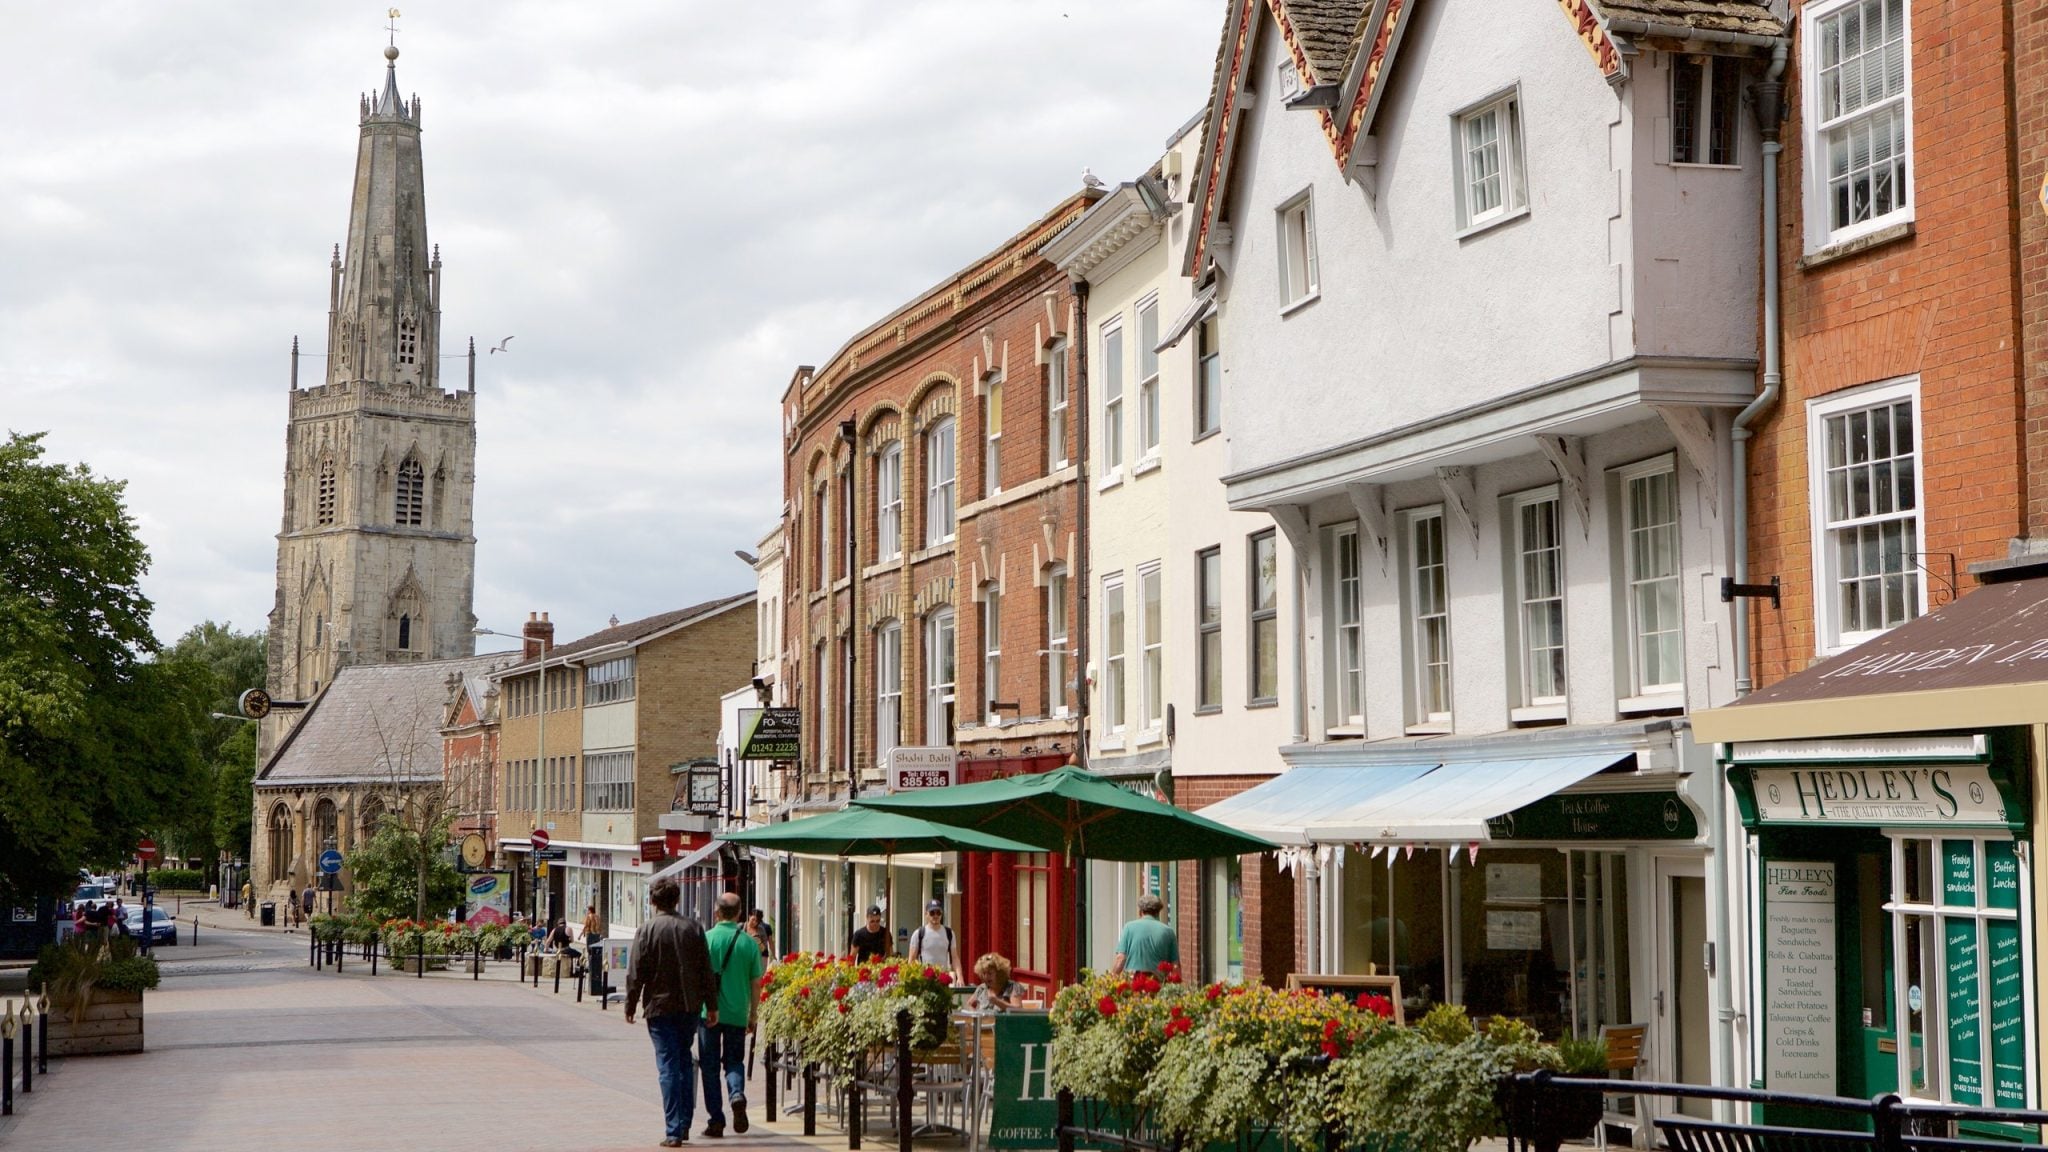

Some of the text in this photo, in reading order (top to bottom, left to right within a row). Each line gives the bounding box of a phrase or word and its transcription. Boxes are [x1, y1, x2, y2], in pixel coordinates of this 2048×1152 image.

[751, 744, 774, 752] 01242
[896, 753, 951, 763] Shahi Balti
[902, 777, 946, 787] 385 386
[1790, 768, 1959, 821] HEDLEY'S
[1560, 798, 1610, 815] Tea & Coffee
[1852, 805, 1883, 820] QUALITY
[1572, 817, 1599, 833] House
[1951, 854, 1971, 869] Freshly
[1993, 861, 2016, 874] Buffet
[1768, 868, 1833, 887] HEDLEY'S
[1953, 869, 1970, 879] made
[1778, 885, 1828, 896] Fine Foods
[1769, 914, 1790, 924] Freshly
[1791, 915, 1809, 923] made
[1817, 916, 1833, 924] order
[1781, 925, 1817, 936] Baguettes
[1777, 938, 1822, 947] Sandwiches
[1768, 951, 1833, 961] Rolls & Ciabattas
[1782, 965, 1817, 975] Hot Food
[1785, 979, 1814, 988] Toasted
[1778, 987, 1822, 997] Sandwiches
[1771, 1001, 1828, 1010] Jacket Potatoes
[1769, 1013, 1831, 1024] Takeaway Coffee
[1783, 1026, 1815, 1037] Crisps &
[1775, 1037, 1820, 1047] Cold Drinks
[1782, 1049, 1818, 1058] Icecreams
[1775, 1070, 1831, 1080] Buffet Lunches
[1958, 1074, 1969, 1083] Shop
[2000, 1080, 2013, 1089] Buffet
[998, 1127, 1042, 1140] COFFEE
